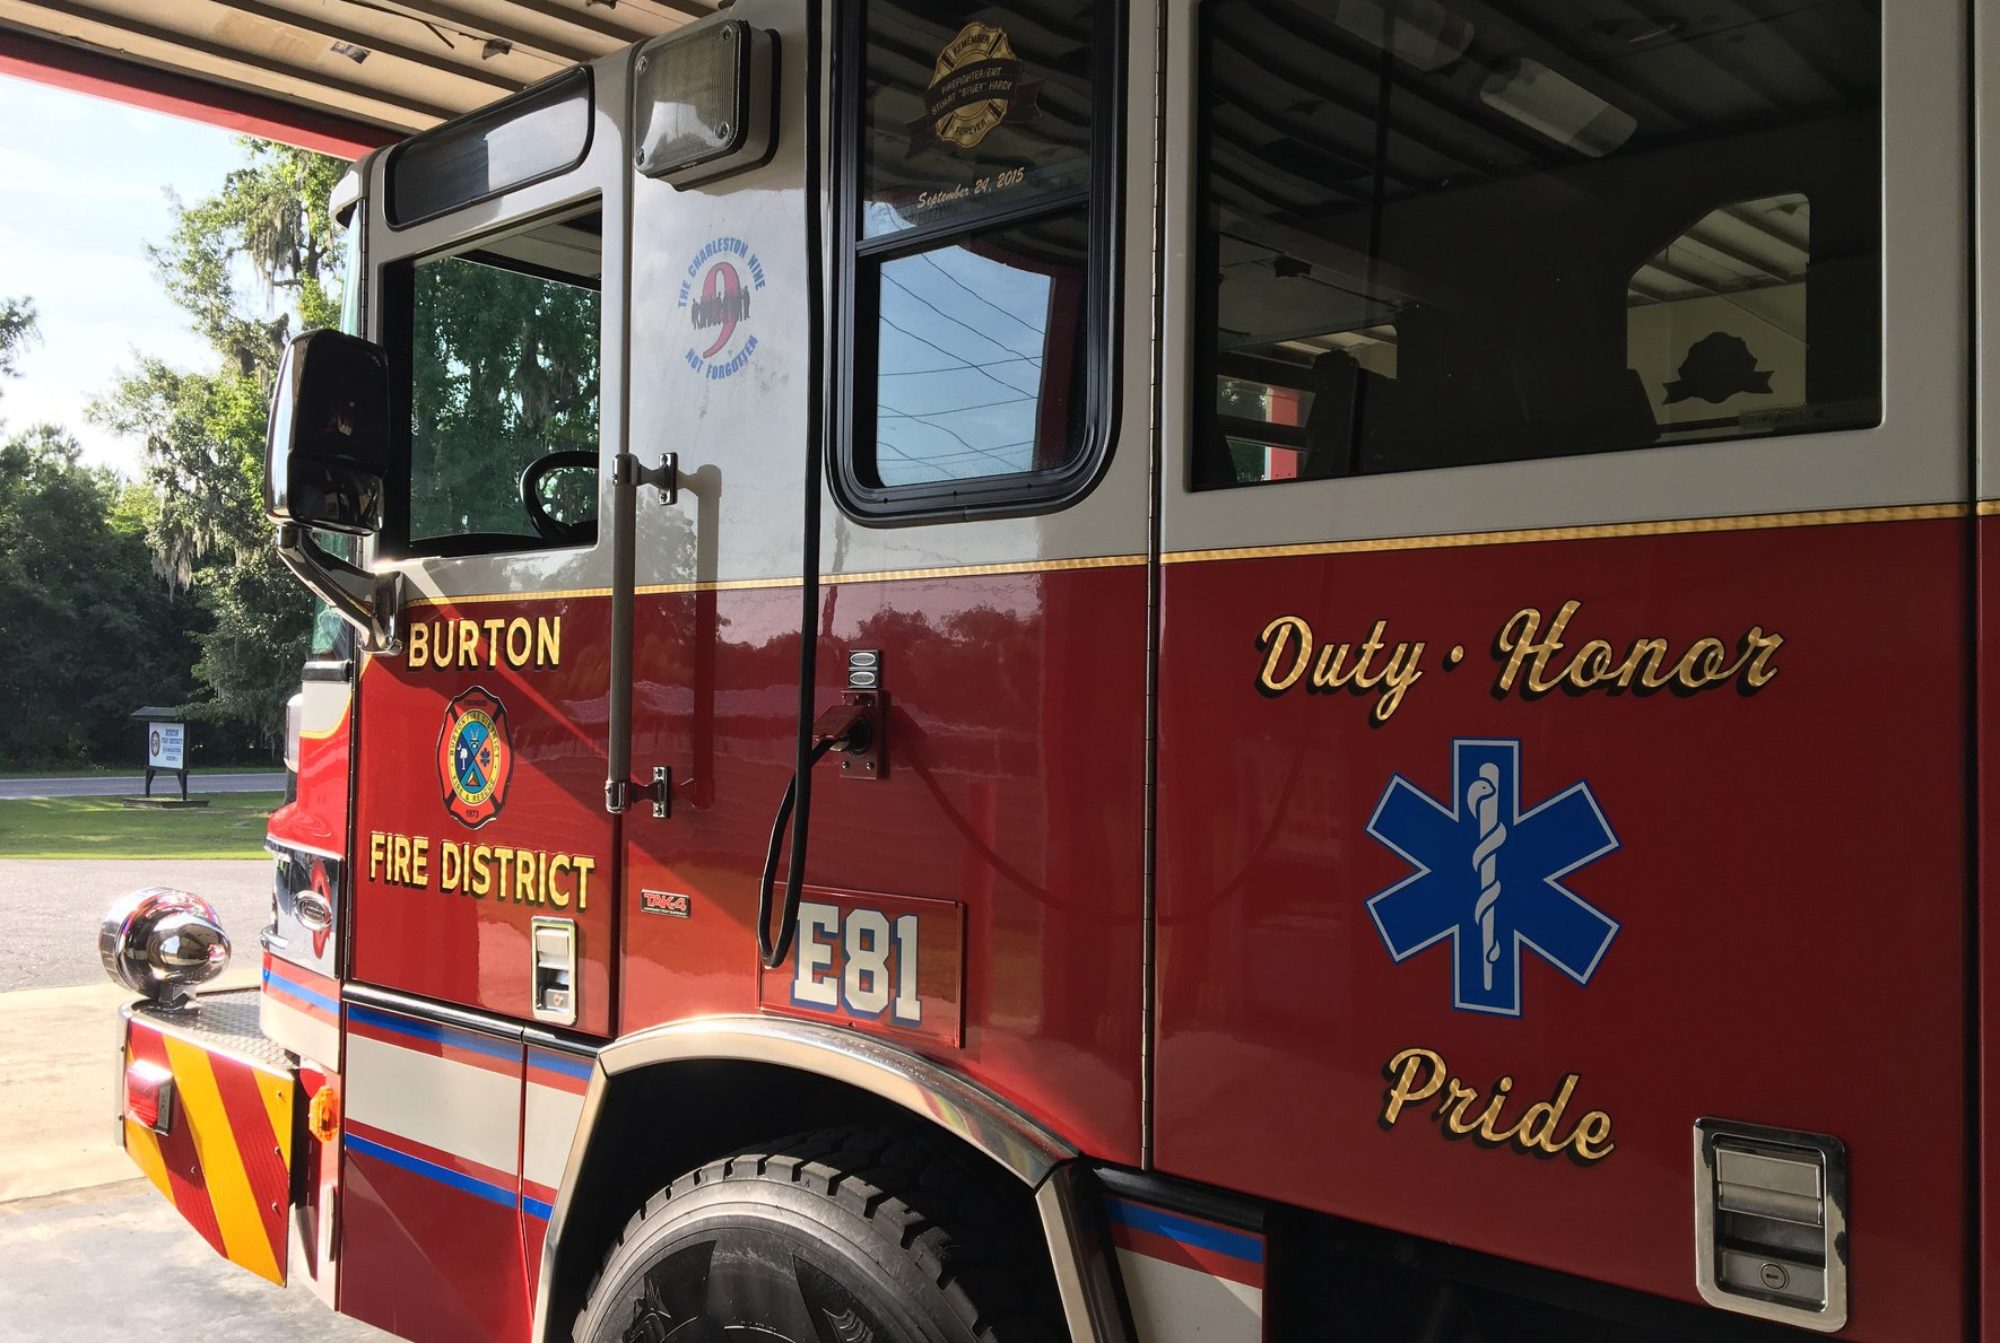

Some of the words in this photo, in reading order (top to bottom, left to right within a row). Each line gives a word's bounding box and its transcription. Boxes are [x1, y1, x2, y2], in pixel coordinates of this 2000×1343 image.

[952, 33, 991, 56] REMEMBER
[955, 118, 987, 136] FOREVER
[917, 183, 969, 209] September
[996, 166, 1025, 189] 2015
[678, 279, 691, 308] THE
[688, 236, 749, 278] CHARLESTON
[747, 253, 766, 291] NINE
[685, 347, 704, 374] NOT
[705, 334, 759, 380] FORGOTTEN
[407, 615, 562, 669] BURTON
[1259, 614, 1428, 723] Duty
[1498, 600, 1785, 694] Honor
[369, 832, 430, 888] FIRE
[440, 840, 595, 909] DISTRICT
[792, 901, 922, 1025] E81
[1383, 1047, 1616, 1162] Pride
